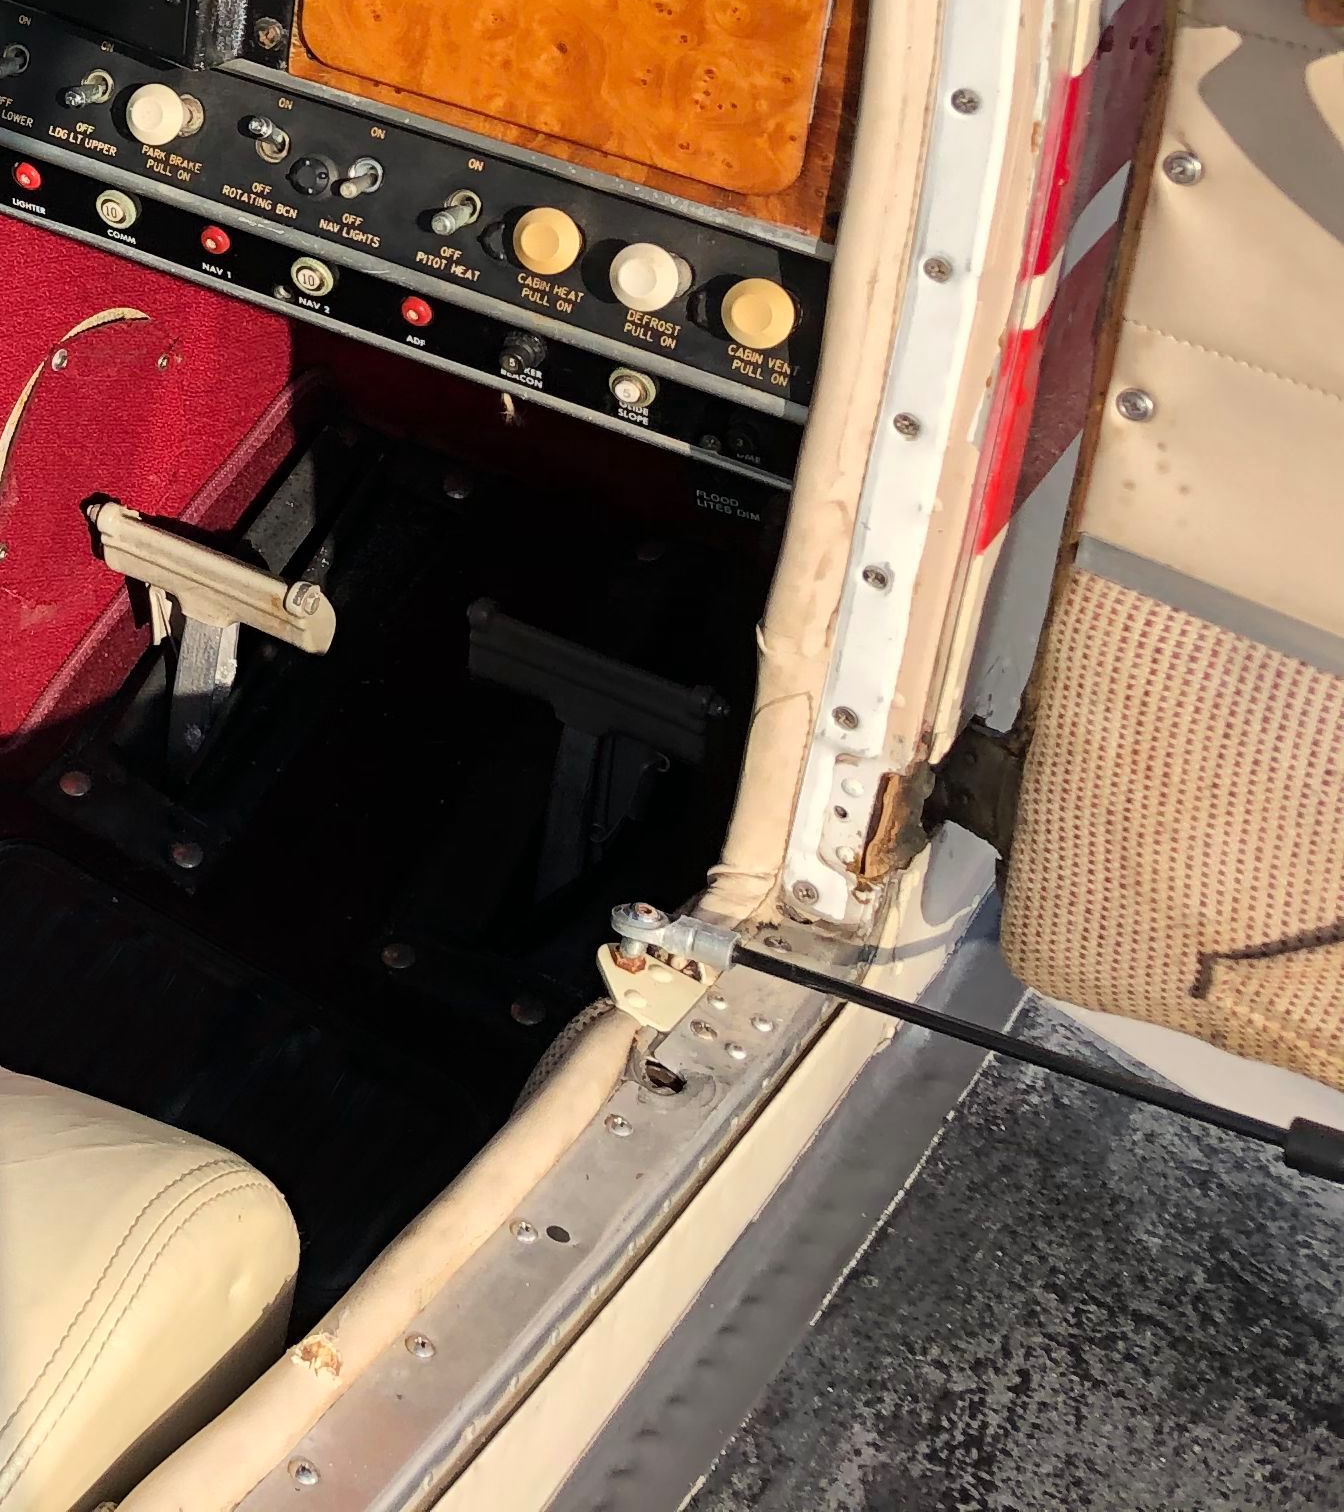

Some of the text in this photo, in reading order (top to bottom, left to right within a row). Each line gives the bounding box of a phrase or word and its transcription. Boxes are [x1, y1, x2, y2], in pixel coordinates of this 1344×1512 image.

[278, 98, 293, 110] ON
[1, 109, 34, 128] LOWER
[76, 122, 95, 136] OFF
[370, 127, 387, 139] ON
[49, 124, 117, 157] LDG LT UPPER
[142, 145, 203, 174] PARK BRAKE
[468, 157, 485, 171] ON
[146, 159, 192, 182] PULL ON
[251, 182, 272, 196] OFF
[12, 197, 46, 215] LIGHTER
[222, 184, 298, 220] ROTATING BCN
[341, 213, 363, 227] OFF
[107, 229, 137, 245] COMM
[318, 218, 381, 249] NAV LIGHTS
[439, 245, 462, 262] OFF
[202, 262, 232, 279] NAV 1
[415, 251, 481, 283] PITOT HEAT
[517, 273, 585, 304] CABIN HEAT
[298, 296, 331, 314] NAV 2
[521, 289, 573, 314] PULL ON
[626, 309, 682, 338] DEFROST
[406, 334, 427, 347] ADF
[623, 322, 677, 350] PULL ON
[727, 344, 800, 376] CABIN VENT
[500, 367, 544, 389] BEACON
[731, 360, 789, 387] PULL ON
[618, 408, 649, 426] SLOPE
[696, 489, 739, 507] FLOOD
[697, 498, 761, 522] LITES DIM
